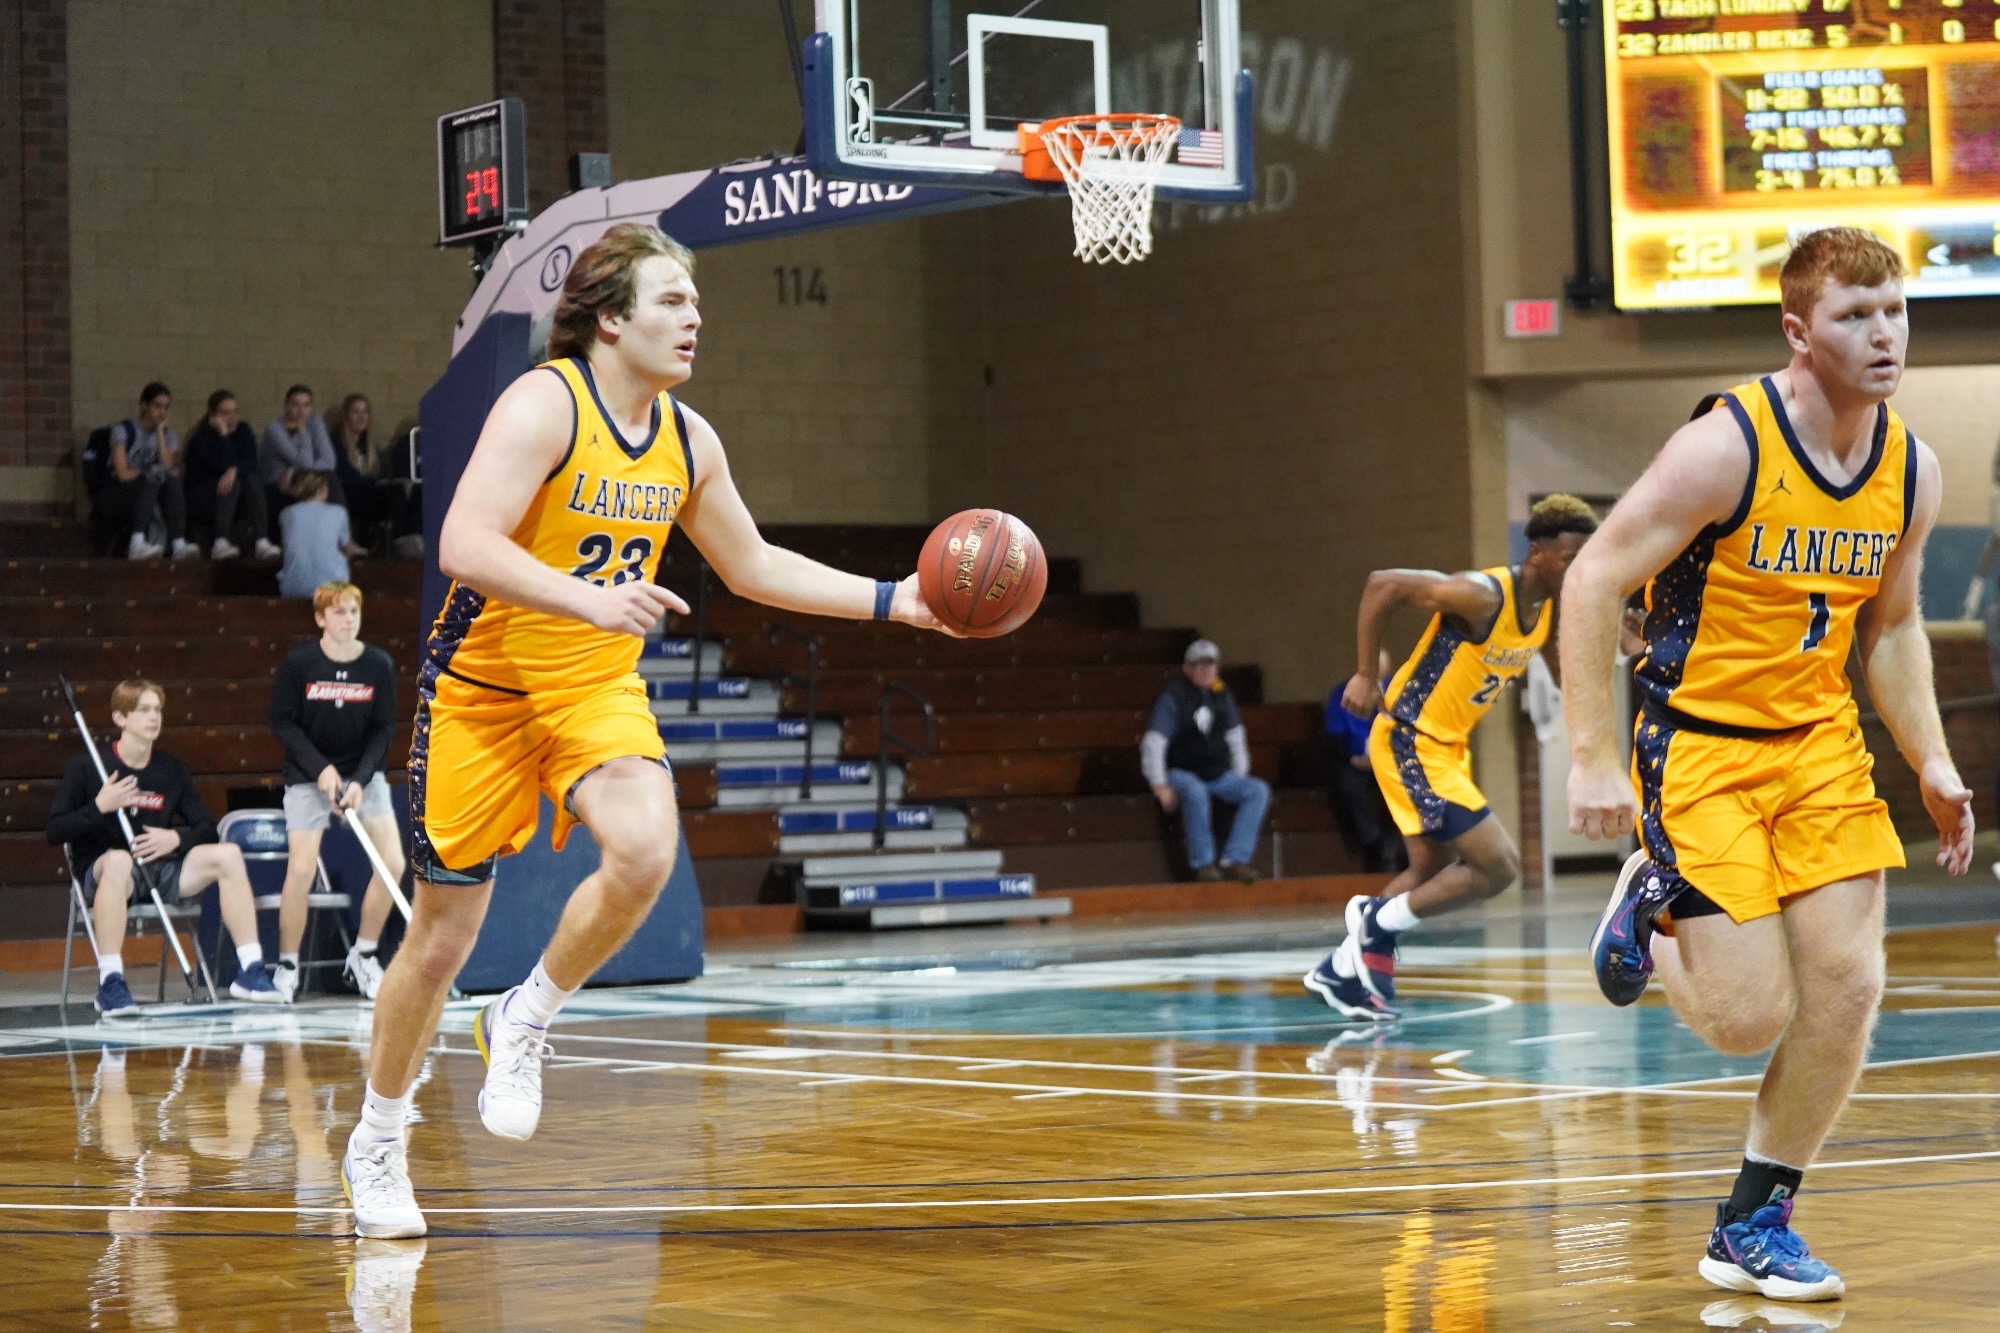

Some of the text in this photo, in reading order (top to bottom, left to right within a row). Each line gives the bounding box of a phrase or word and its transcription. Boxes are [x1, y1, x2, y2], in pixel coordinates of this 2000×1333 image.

[1617, 32, 1657, 58] 32
[1756, 28, 1814, 49] BENZ
[1825, 24, 1849, 48] 5
[1889, 22, 1904, 45] 1
[1942, 19, 1965, 43] 0
[1764, 68, 1884, 88] FIELD GOALS
[1820, 85, 1880, 108] 50.0
[1882, 83, 1904, 105] %
[1786, 110, 1842, 128] FIELD
[1843, 107, 1906, 125] GOALS
[1750, 123, 1903, 150] 7-15 46.7 %
[845, 147, 888, 159] SPALDING
[1763, 149, 1893, 170] FREE THROWS
[465, 166, 499, 215] 29
[1755, 164, 1901, 192] 3-4 75.0 %
[1665, 233, 1730, 273] 32
[774, 266, 828, 306] 114
[566, 470, 681, 523] LANCERS
[570, 531, 653, 590] 23
[952, 515, 998, 596] SPALDING
[1800, 592, 1832, 654] 1
[306, 684, 374, 700] BASKETBALL
[999, 879, 1017, 893] 116
